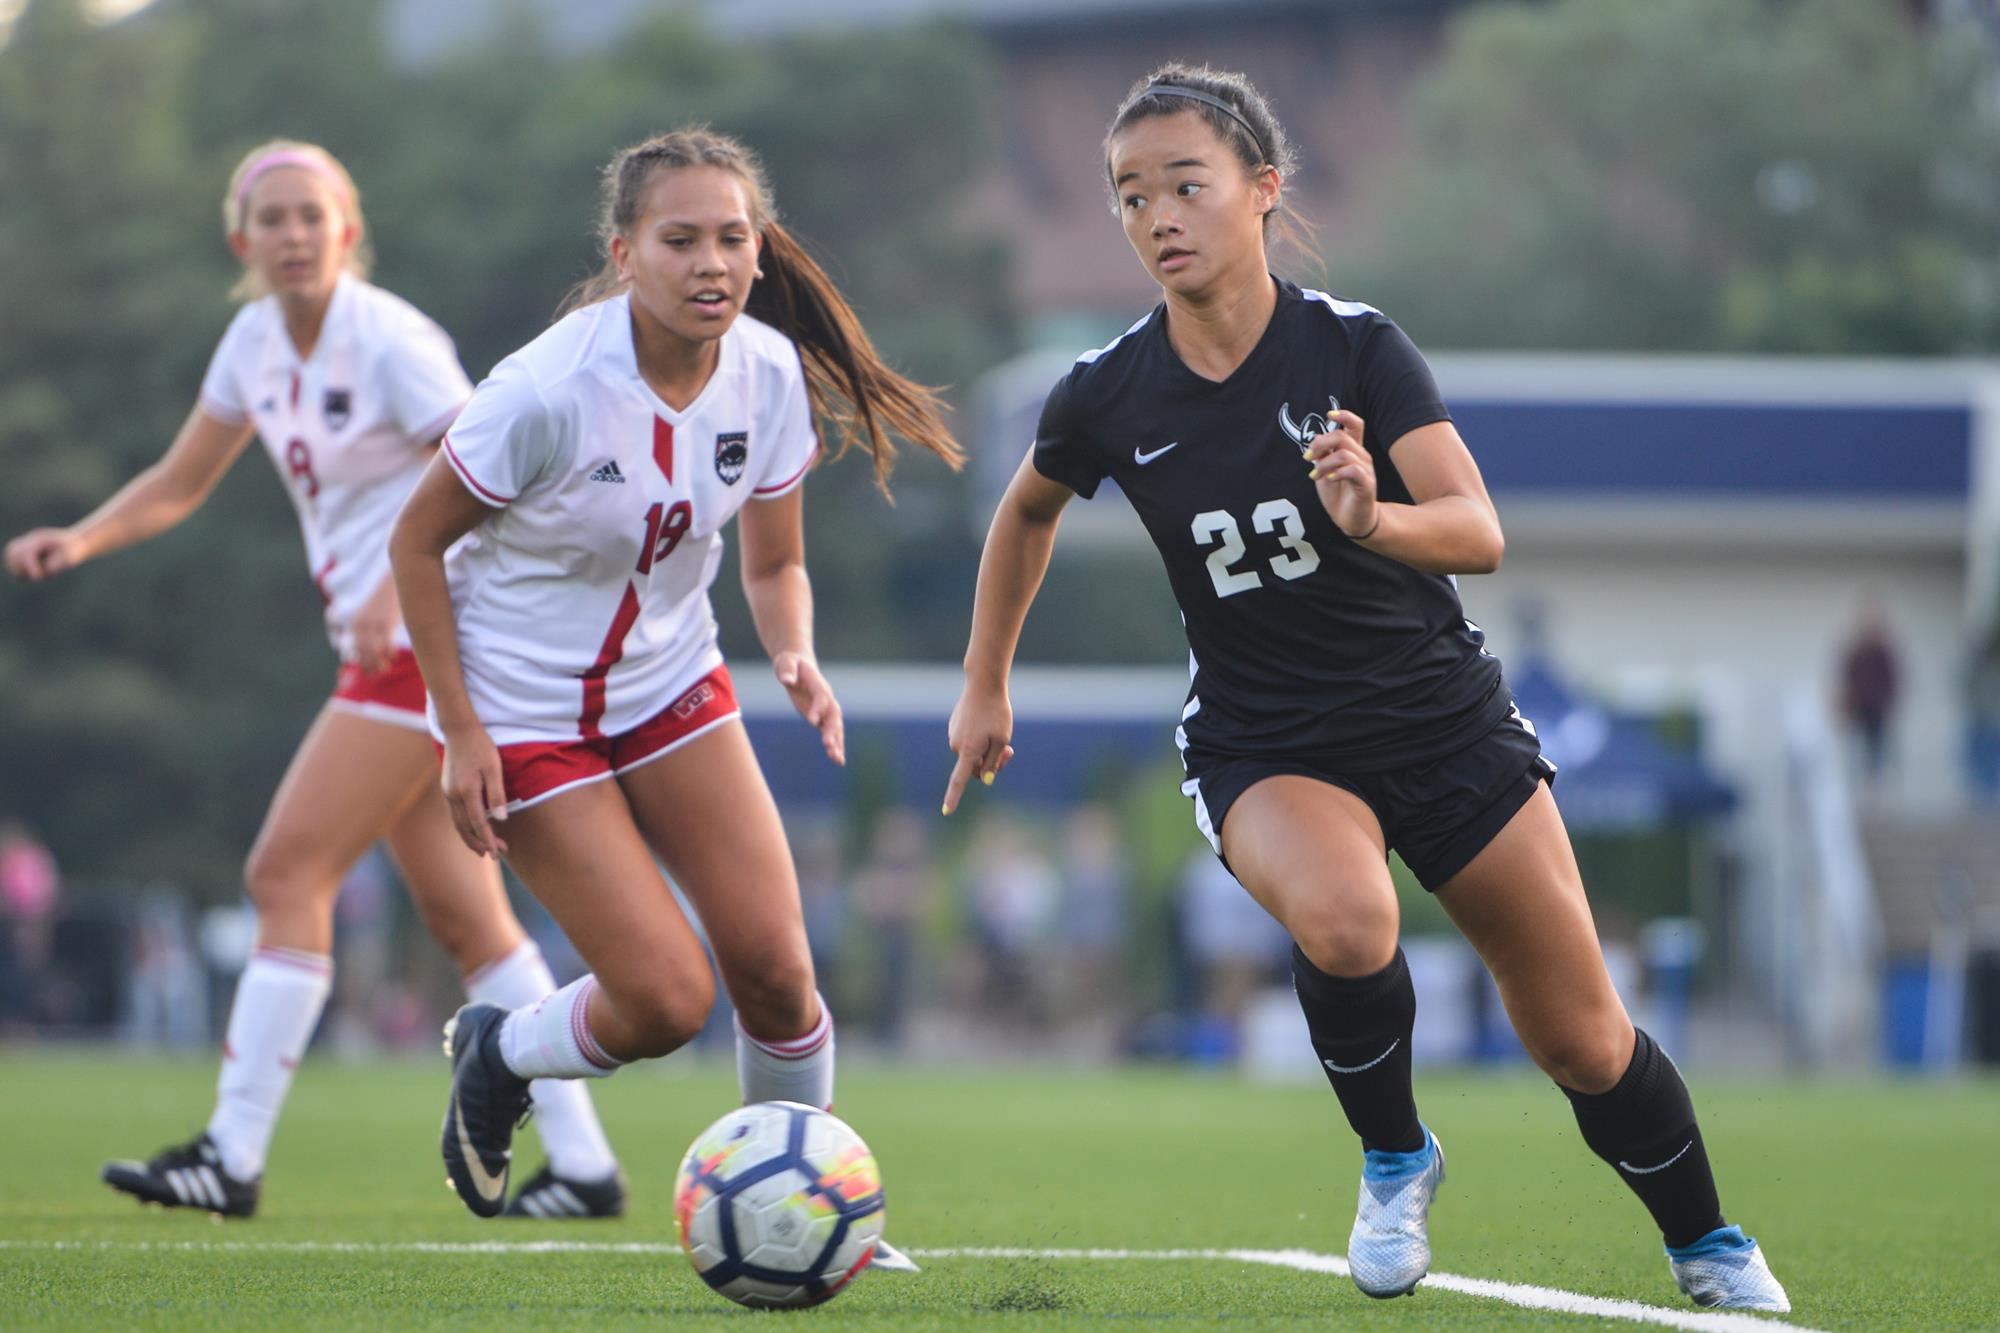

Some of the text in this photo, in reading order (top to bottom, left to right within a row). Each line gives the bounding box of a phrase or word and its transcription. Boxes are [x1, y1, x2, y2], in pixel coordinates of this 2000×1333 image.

[287, 439, 320, 499] 9
[590, 473, 626, 484] adidas
[636, 500, 692, 575] 19
[1191, 498, 1321, 598] 23
